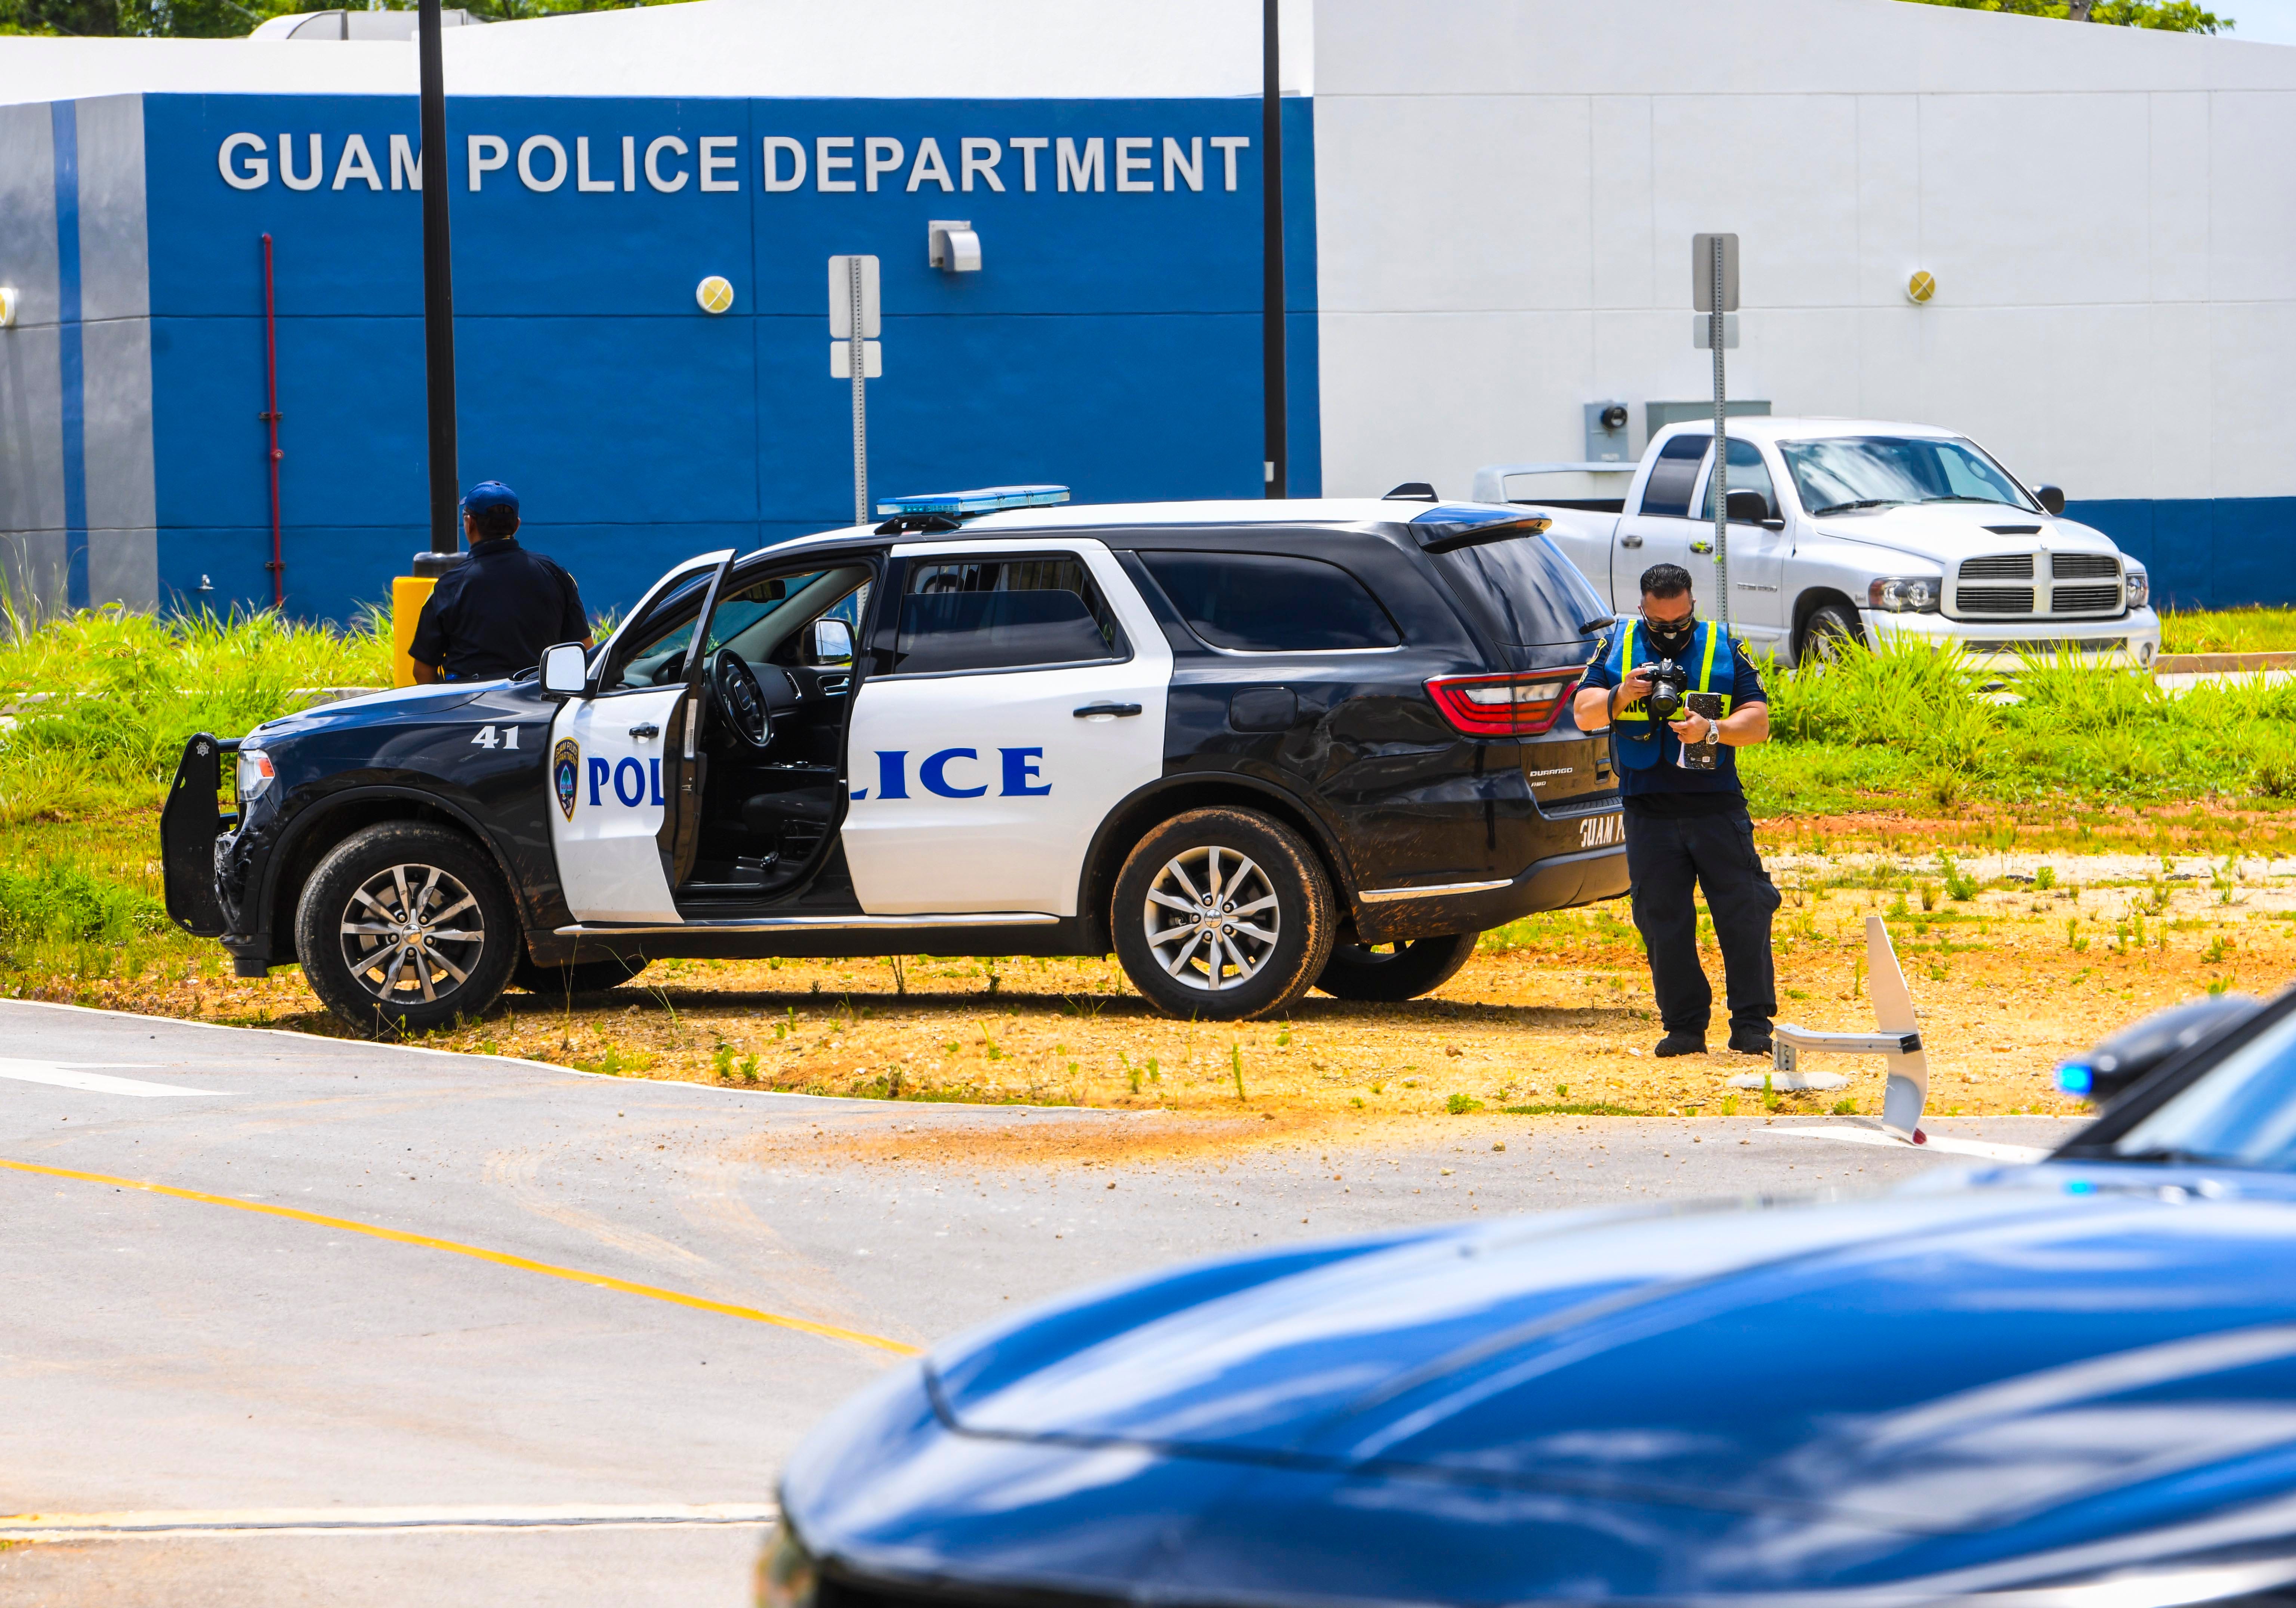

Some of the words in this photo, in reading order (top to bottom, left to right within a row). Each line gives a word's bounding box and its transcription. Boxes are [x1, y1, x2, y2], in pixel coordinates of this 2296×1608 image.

[218, 132, 423, 191] GUAM
[467, 134, 740, 193] POLICE
[763, 136, 1250, 192] DEPARTMENT
[471, 725, 520, 749] 41
[556, 742, 566, 757] GUAM
[567, 742, 577, 759] POLICE
[1530, 767, 1573, 777] DURANGO
[1580, 816, 1614, 848] GUAM
